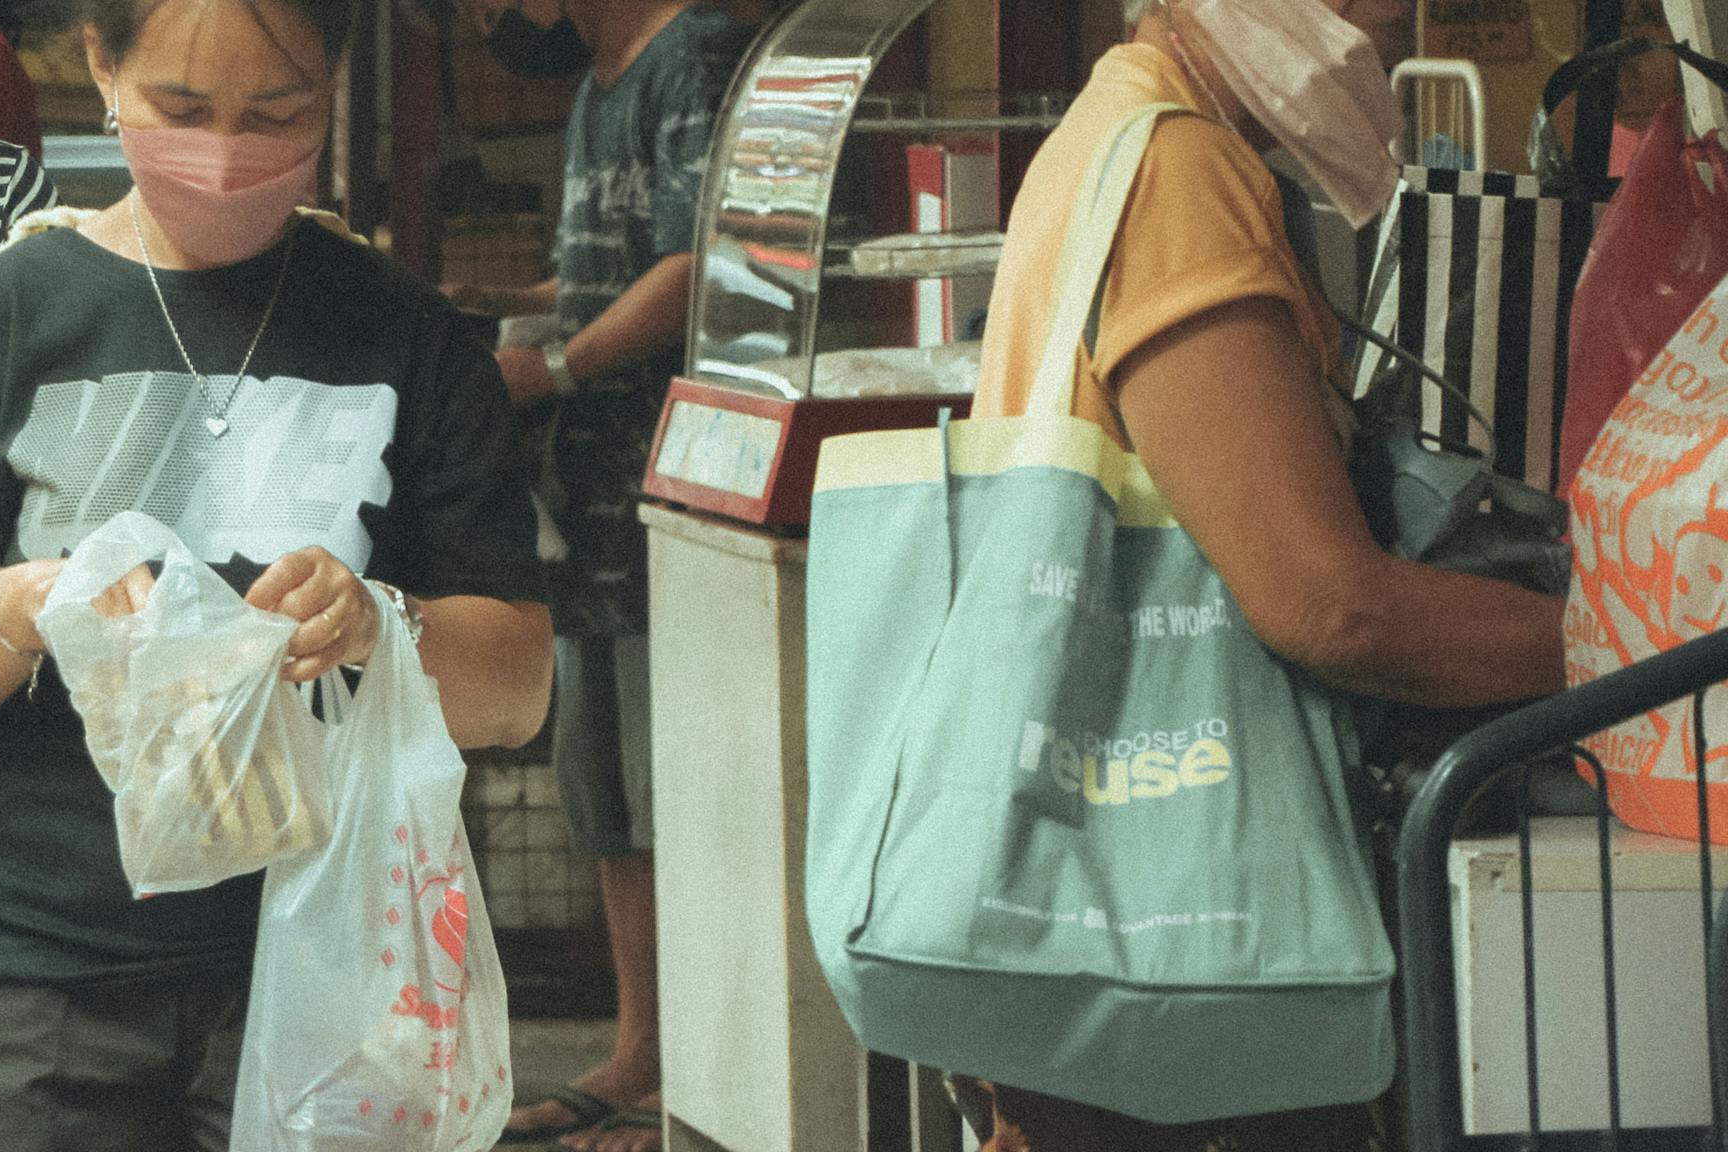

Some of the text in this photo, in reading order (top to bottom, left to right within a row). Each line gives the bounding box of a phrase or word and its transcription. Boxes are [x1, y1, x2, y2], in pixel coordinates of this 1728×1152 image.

[1029, 563, 1079, 601] SAVE
[1194, 717, 1228, 743] TO
[1019, 720, 1233, 805] reuse
